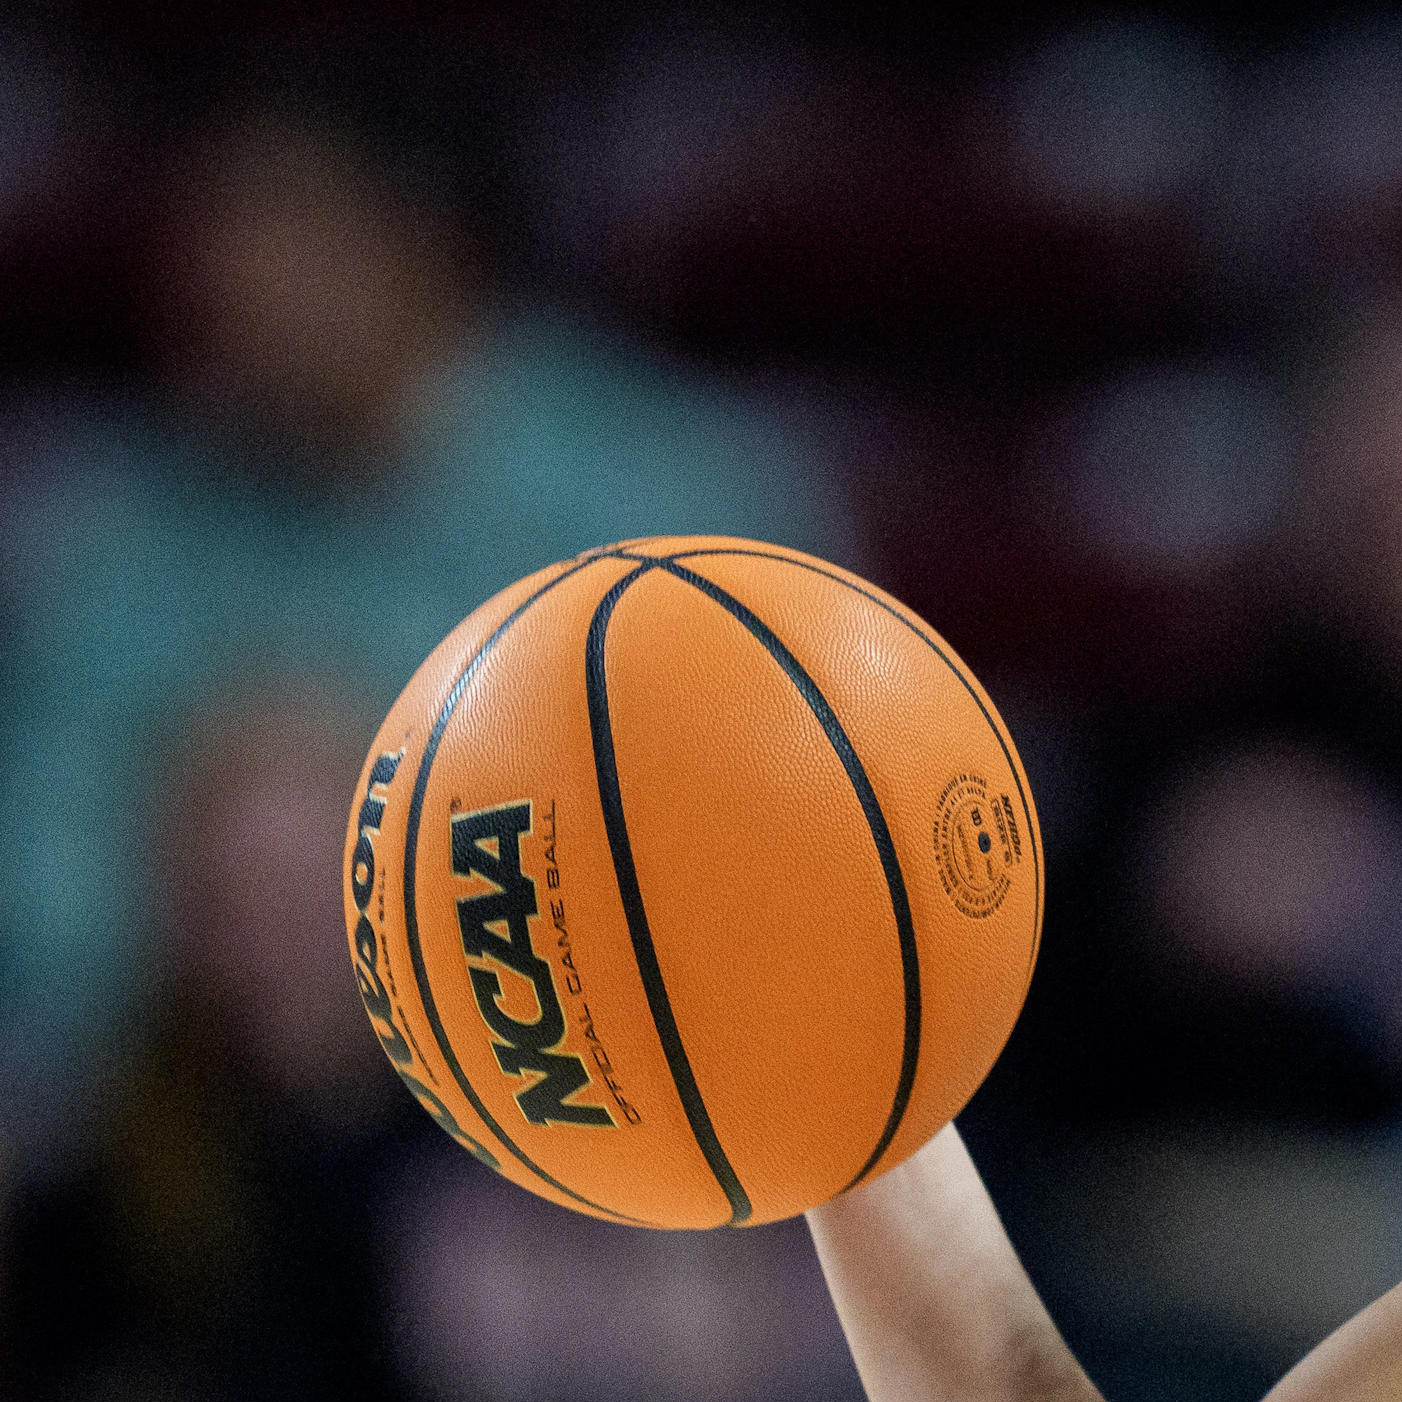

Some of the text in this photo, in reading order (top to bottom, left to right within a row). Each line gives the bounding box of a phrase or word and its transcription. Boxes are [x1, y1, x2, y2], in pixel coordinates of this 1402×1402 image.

[542, 799, 563, 891] BALL
[448, 799, 618, 1129] NCAA
[549, 897, 583, 996] GAME
